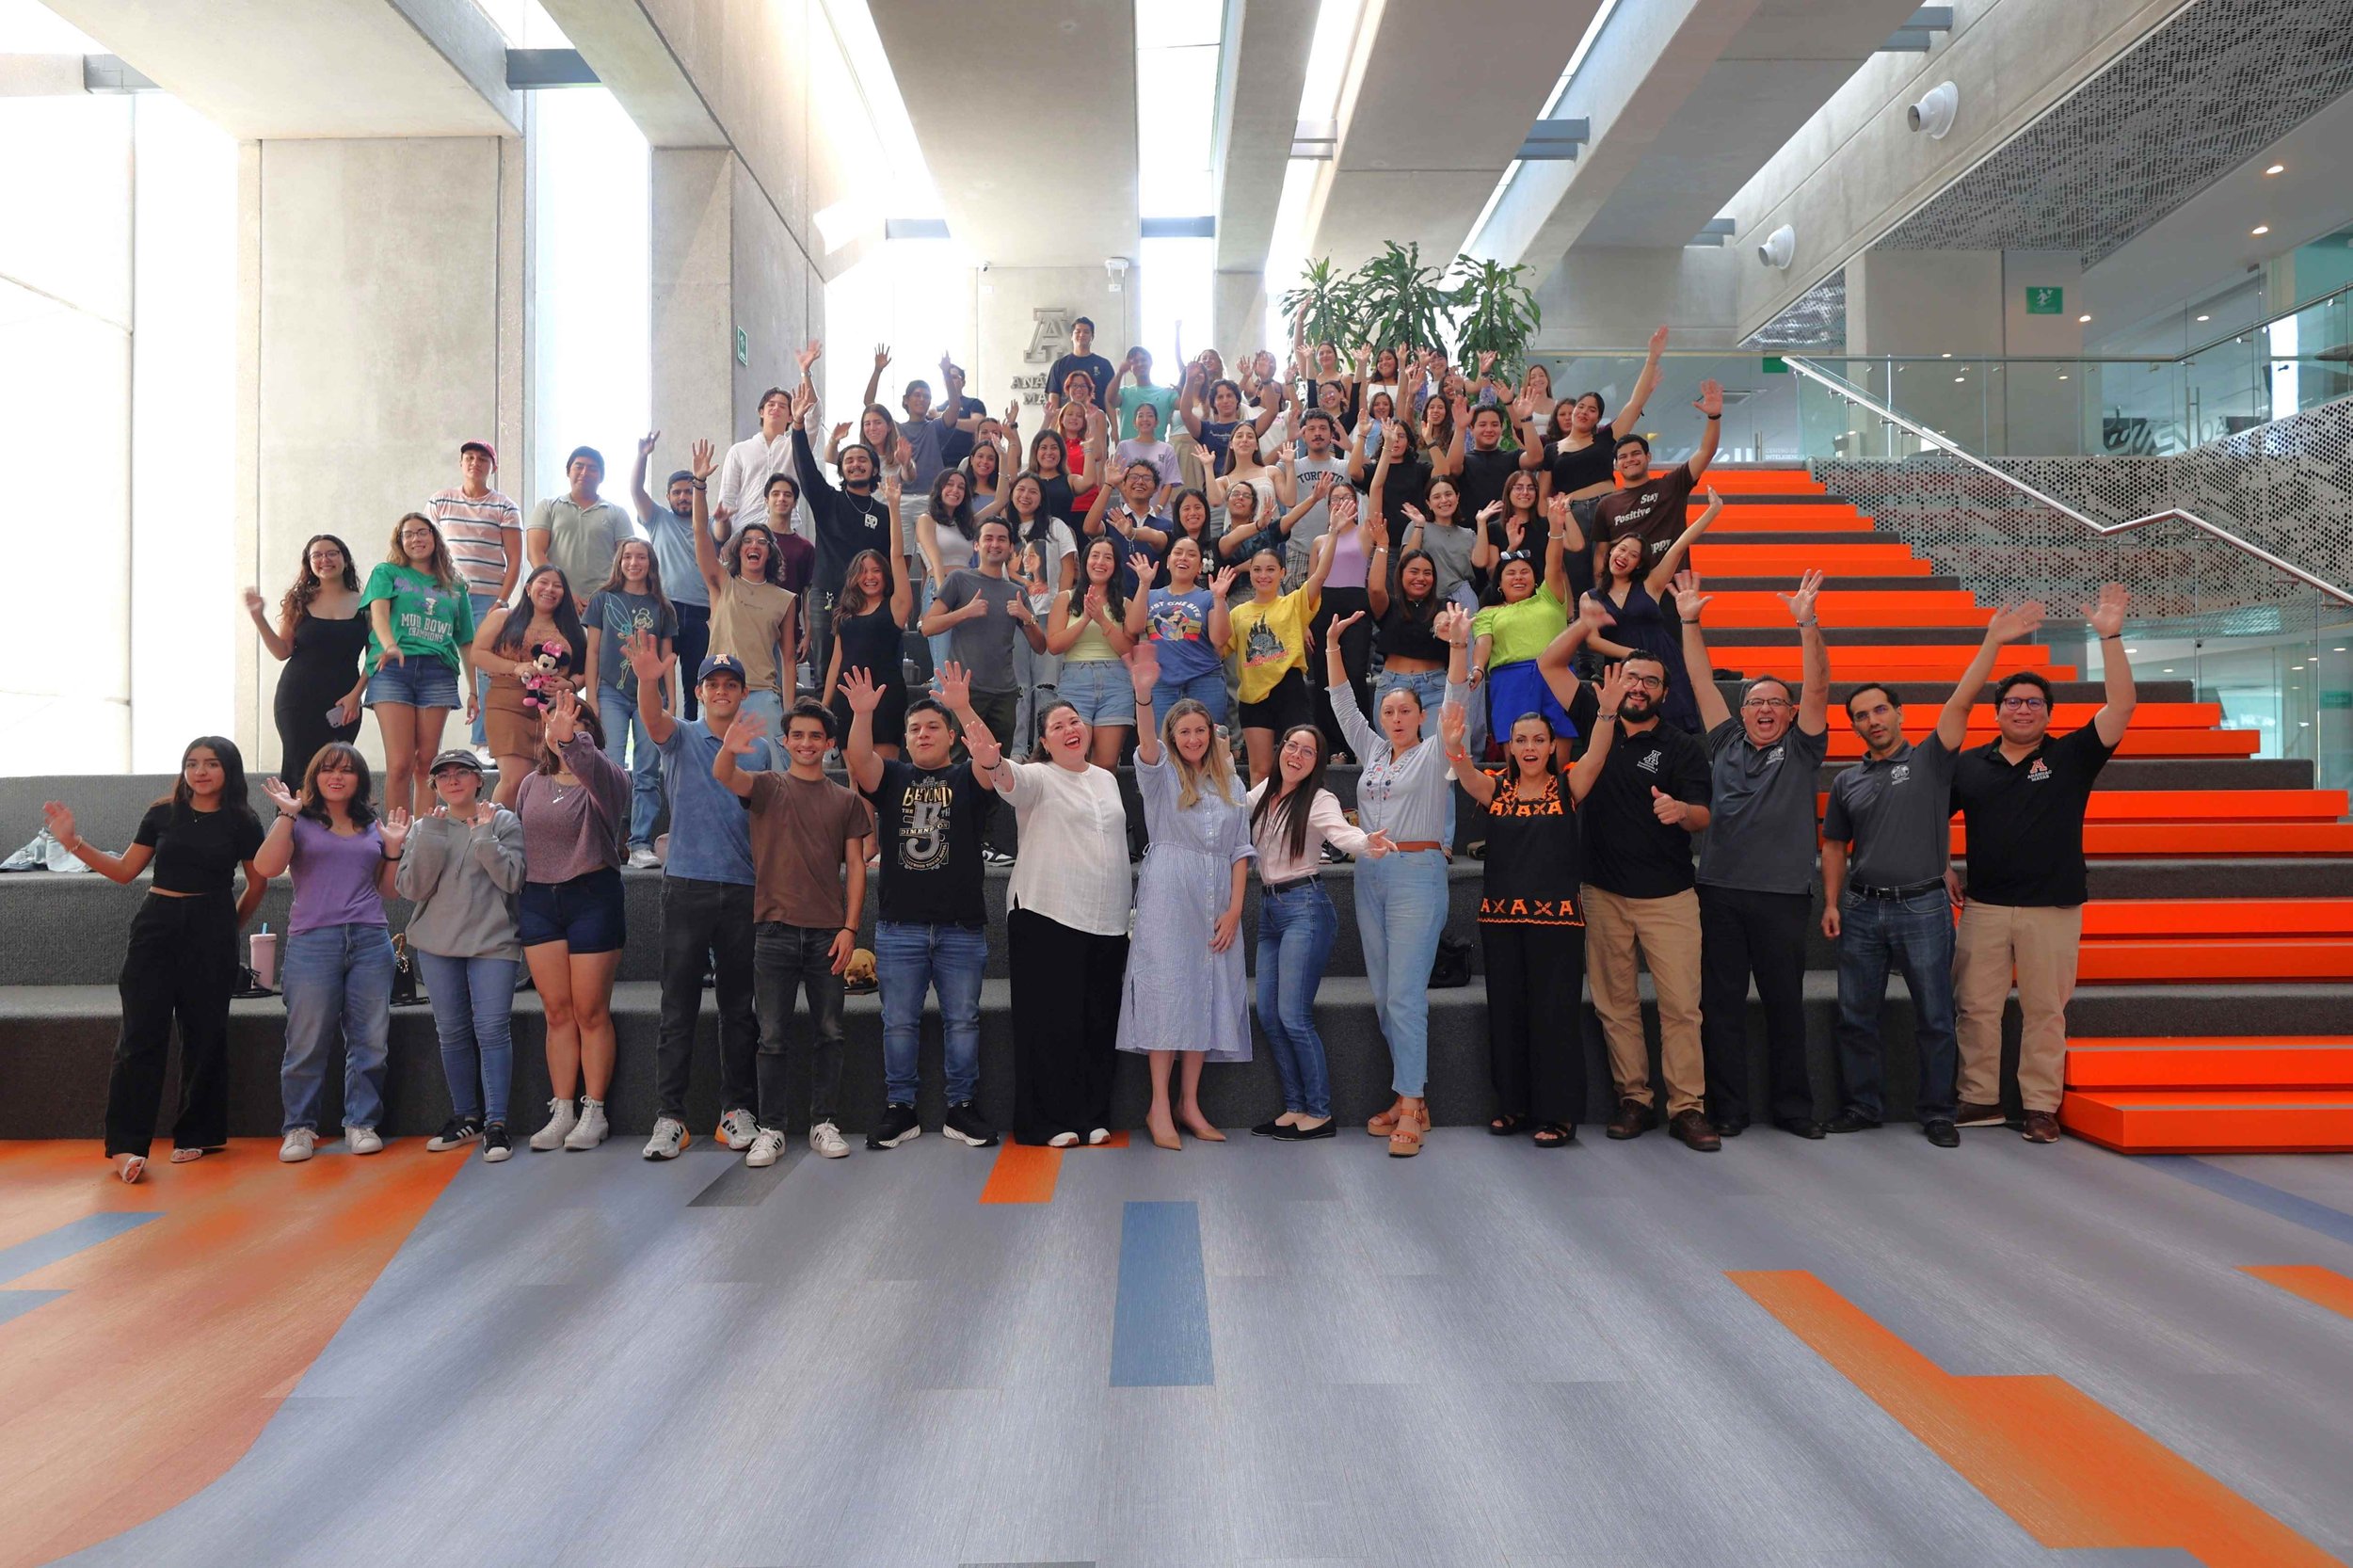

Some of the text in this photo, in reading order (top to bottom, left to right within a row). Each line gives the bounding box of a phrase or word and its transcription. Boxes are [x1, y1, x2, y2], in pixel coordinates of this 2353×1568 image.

[1023, 308, 1068, 363] A
[1011, 373, 1047, 390] ANÁ
[1023, 392, 1048, 406] MA
[1297, 471, 1344, 484] TOROTO
[1641, 492, 1659, 504] Stay
[1614, 507, 1651, 526] Positive
[1651, 539, 1672, 555] ppy
[1187, 602, 1202, 618] BITE
[401, 613, 453, 636] MUD BOWL
[408, 627, 444, 643] CHAMPIONS
[713, 653, 731, 665] A
[1643, 750, 1662, 766] A
[2030, 758, 2048, 774] A
[902, 787, 953, 808] BEYOND
